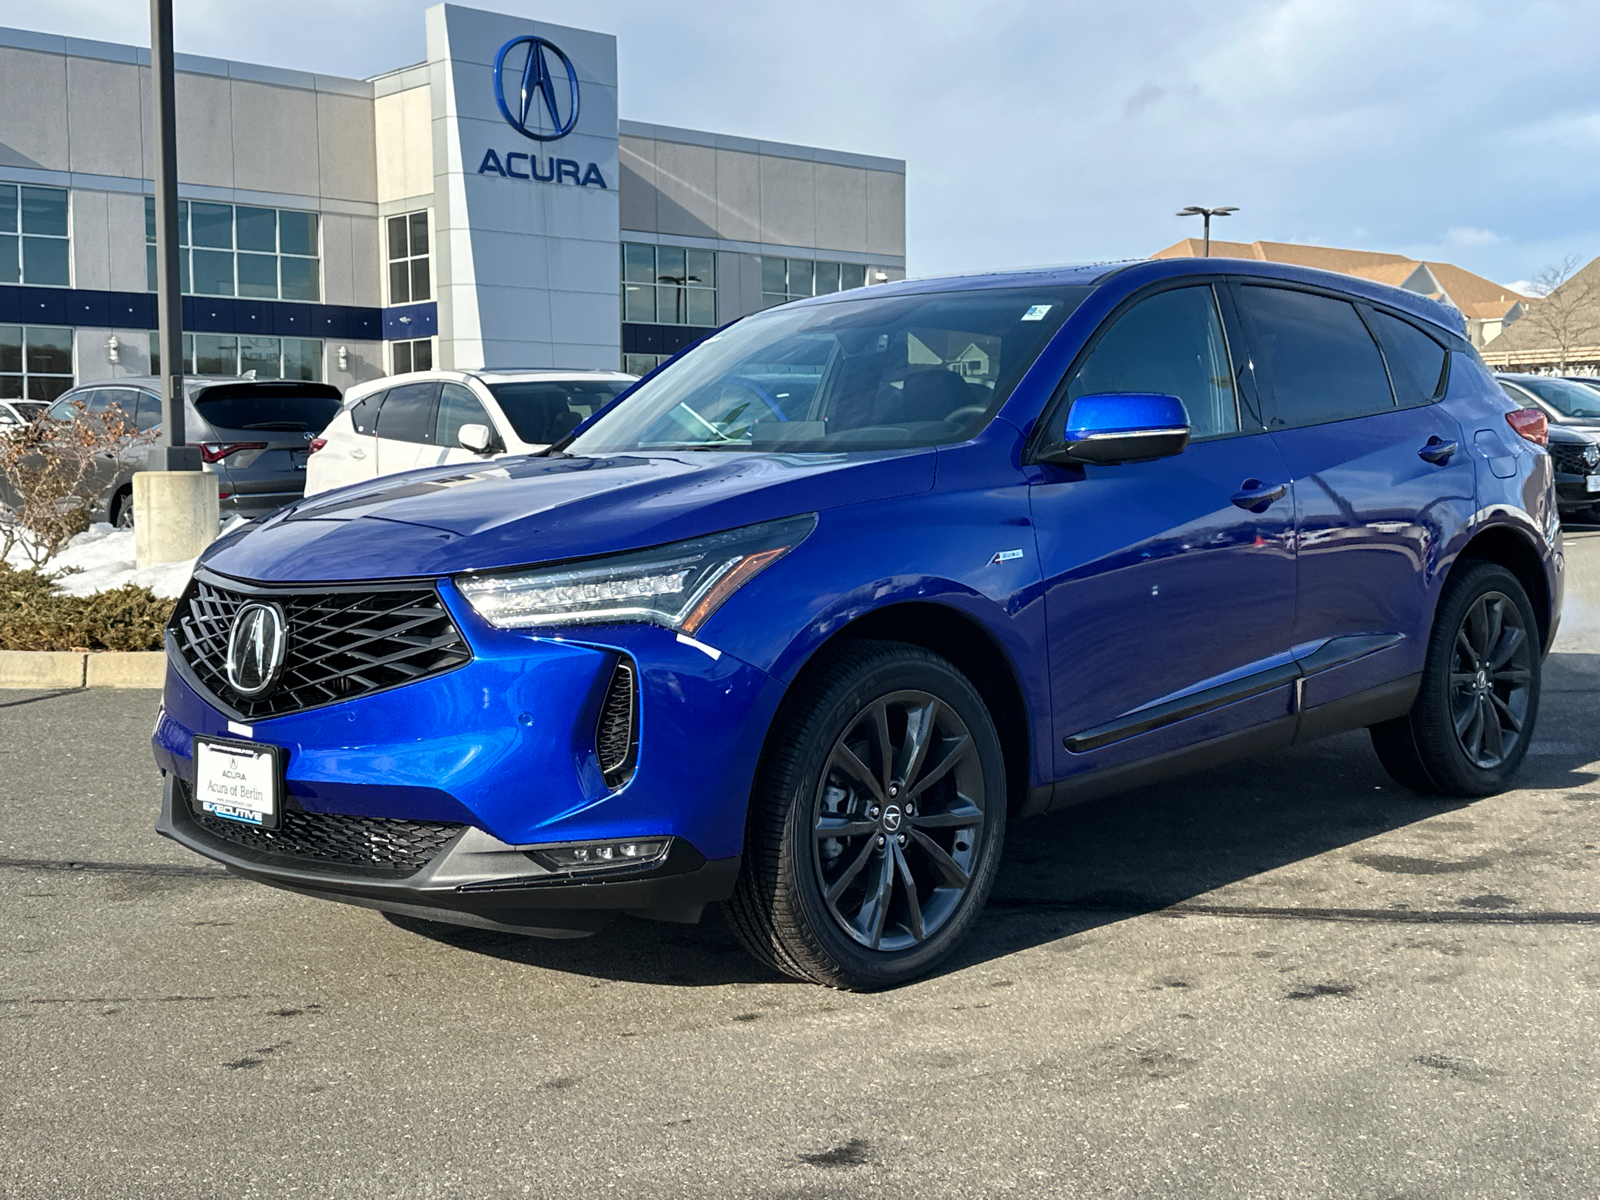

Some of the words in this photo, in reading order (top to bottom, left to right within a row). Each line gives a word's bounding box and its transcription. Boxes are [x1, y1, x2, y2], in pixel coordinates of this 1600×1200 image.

[478, 148, 607, 189] ACURA
[222, 770, 247, 781] ACURA
[207, 779, 229, 795] Acura
[229, 785, 238, 796] of
[240, 785, 263, 801] Berlin
